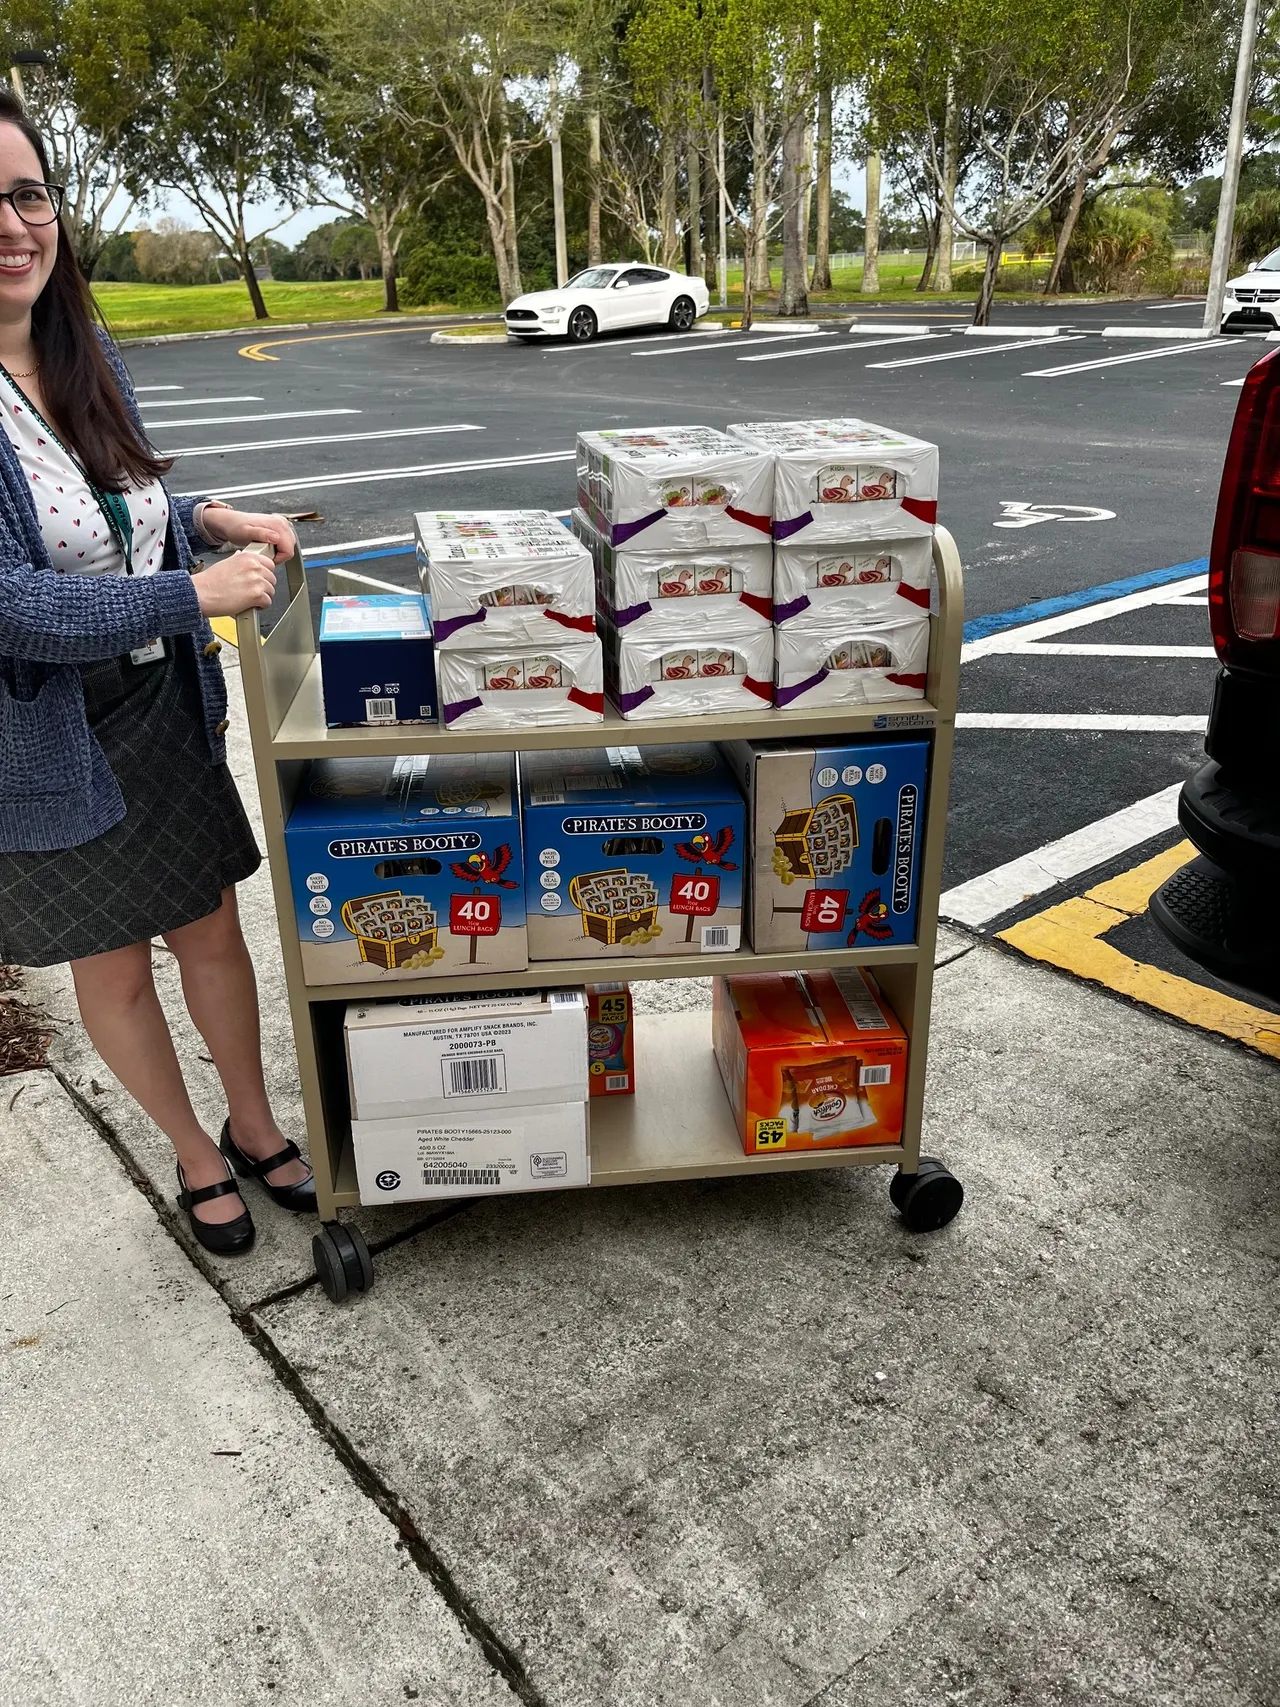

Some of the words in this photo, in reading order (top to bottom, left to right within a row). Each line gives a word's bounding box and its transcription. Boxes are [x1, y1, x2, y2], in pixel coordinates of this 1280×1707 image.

[573, 818, 637, 832] PIRATE'S
[642, 816, 695, 829] BOOTY
[899, 794, 914, 853] PIRATE'S
[340, 839, 408, 855] PIRATE'S
[413, 836, 468, 850] BOOTY
[895, 857, 909, 902] BOOTY
[678, 881, 710, 901] 40
[458, 901, 490, 920] 40
[818, 896, 839, 923] 40
[476, 990, 527, 1000] BOOTY
[602, 999, 625, 1012] 45
[404, 1028, 446, 1037] MANUFACTURED
[449, 1039, 497, 1050] 2000073-PB
[811, 1084, 838, 1094] CHEDDAR
[813, 1099, 841, 1116] Goldfish
[758, 1131, 783, 1144] 45
